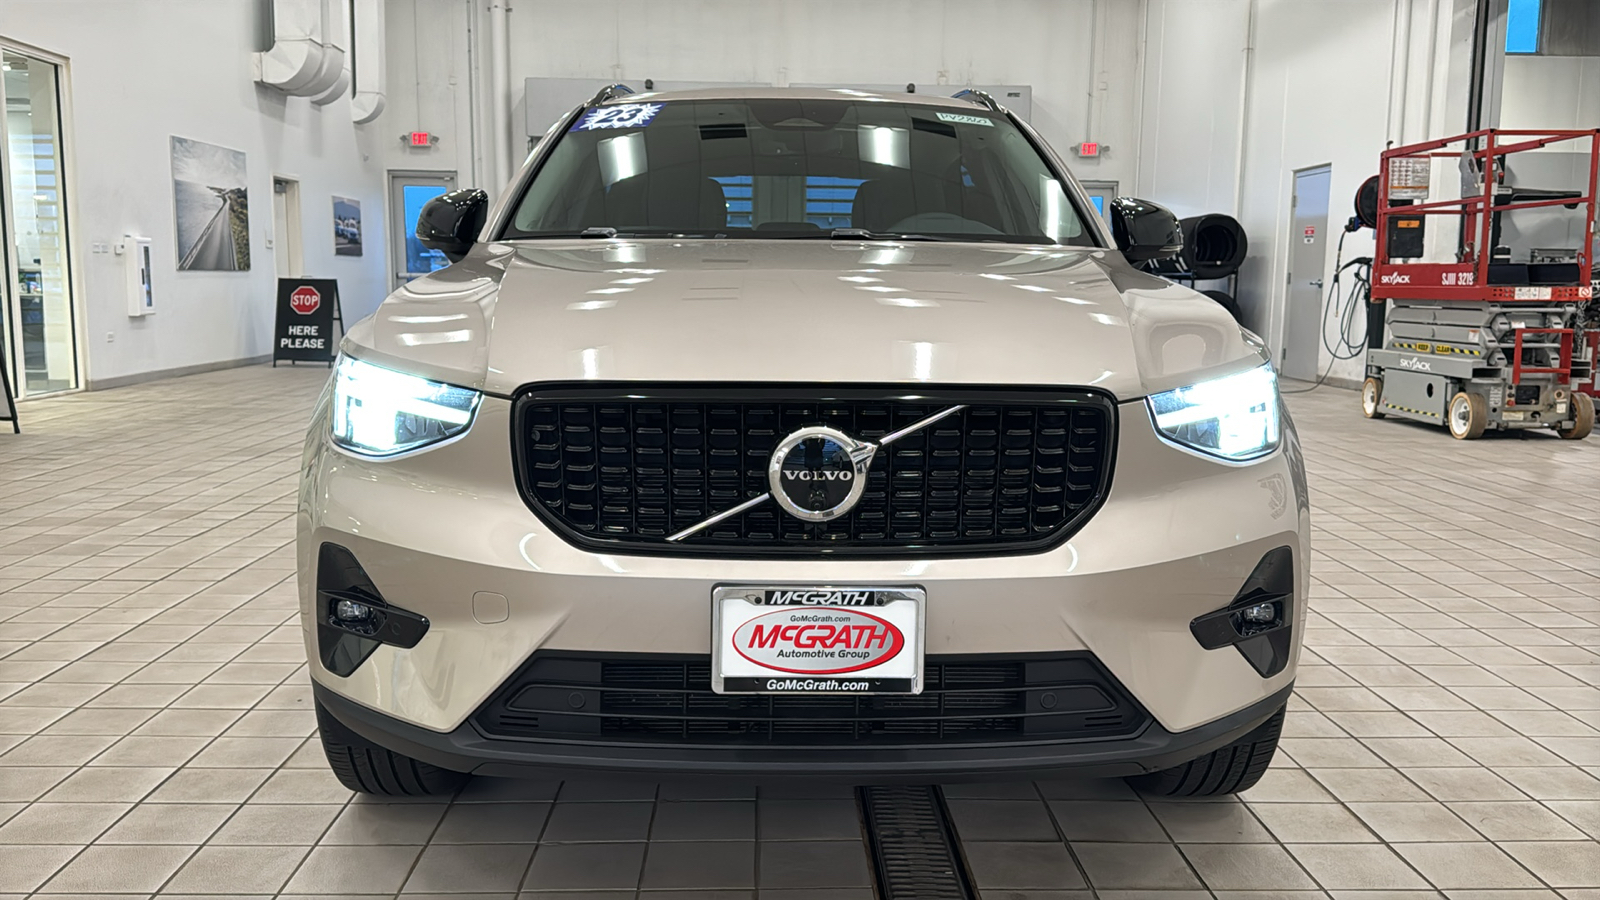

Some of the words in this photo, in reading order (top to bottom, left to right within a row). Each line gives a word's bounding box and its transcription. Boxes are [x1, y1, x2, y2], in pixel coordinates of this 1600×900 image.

[594, 108, 643, 123] 23
[1381, 271, 1410, 285] SKYJACK
[293, 295, 318, 306] STOP
[288, 325, 319, 336] HERE
[280, 338, 325, 349] PLEASE
[1400, 357, 1431, 371] SKYJACK
[783, 470, 852, 481] VOLVO
[790, 615, 851, 623] GoMcGrath.com
[776, 649, 836, 659] Automotive
[838, 649, 870, 660] Group
[766, 679, 869, 691] GoMcGrath.com
